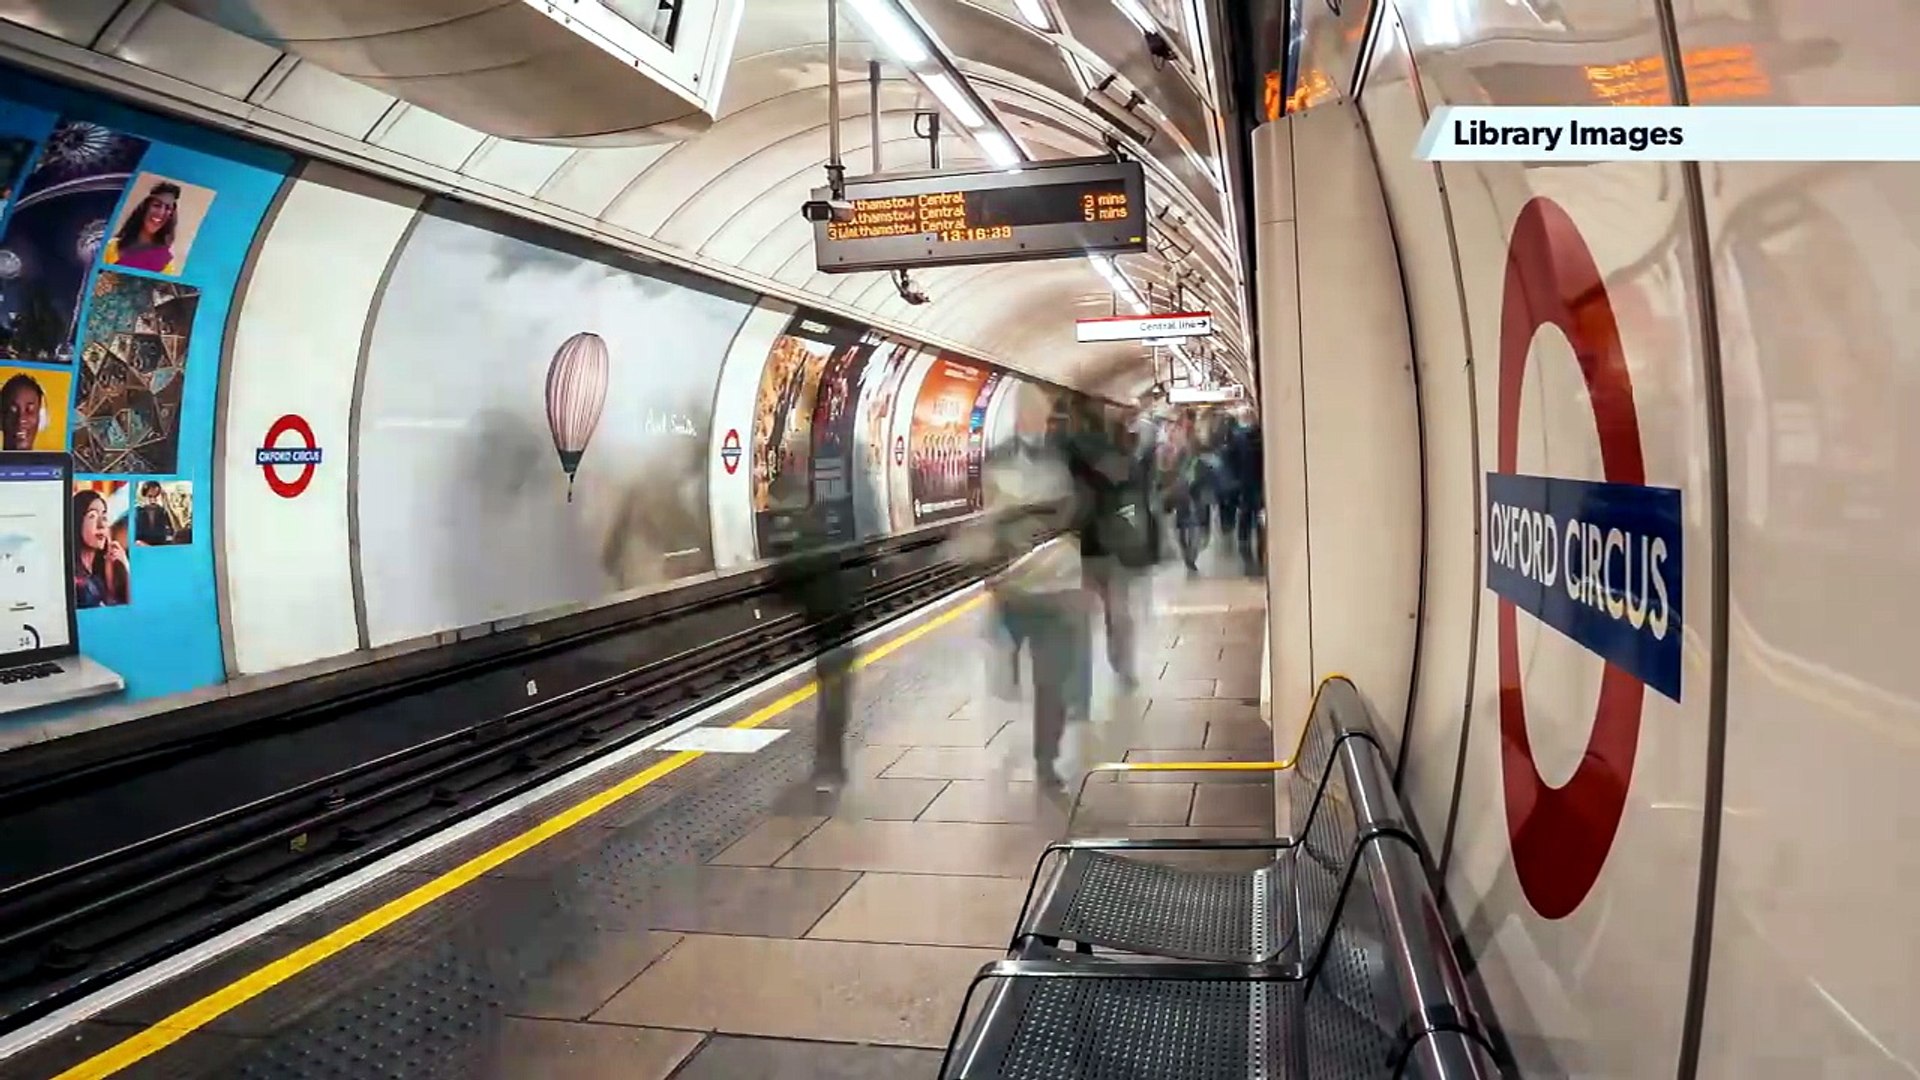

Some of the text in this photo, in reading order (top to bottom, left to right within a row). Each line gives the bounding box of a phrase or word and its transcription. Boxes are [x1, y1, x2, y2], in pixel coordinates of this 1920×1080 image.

[918, 192, 965, 207] Central
[1084, 195, 1095, 209] 3
[1098, 193, 1127, 206] mins
[919, 204, 966, 220] Central
[1085, 208, 1095, 222] 5
[1099, 207, 1128, 220] mins
[920, 218, 967, 233] Central
[1140, 319, 1197, 331] Central line
[1490, 502, 1669, 641] OXFORD CIRCUS
